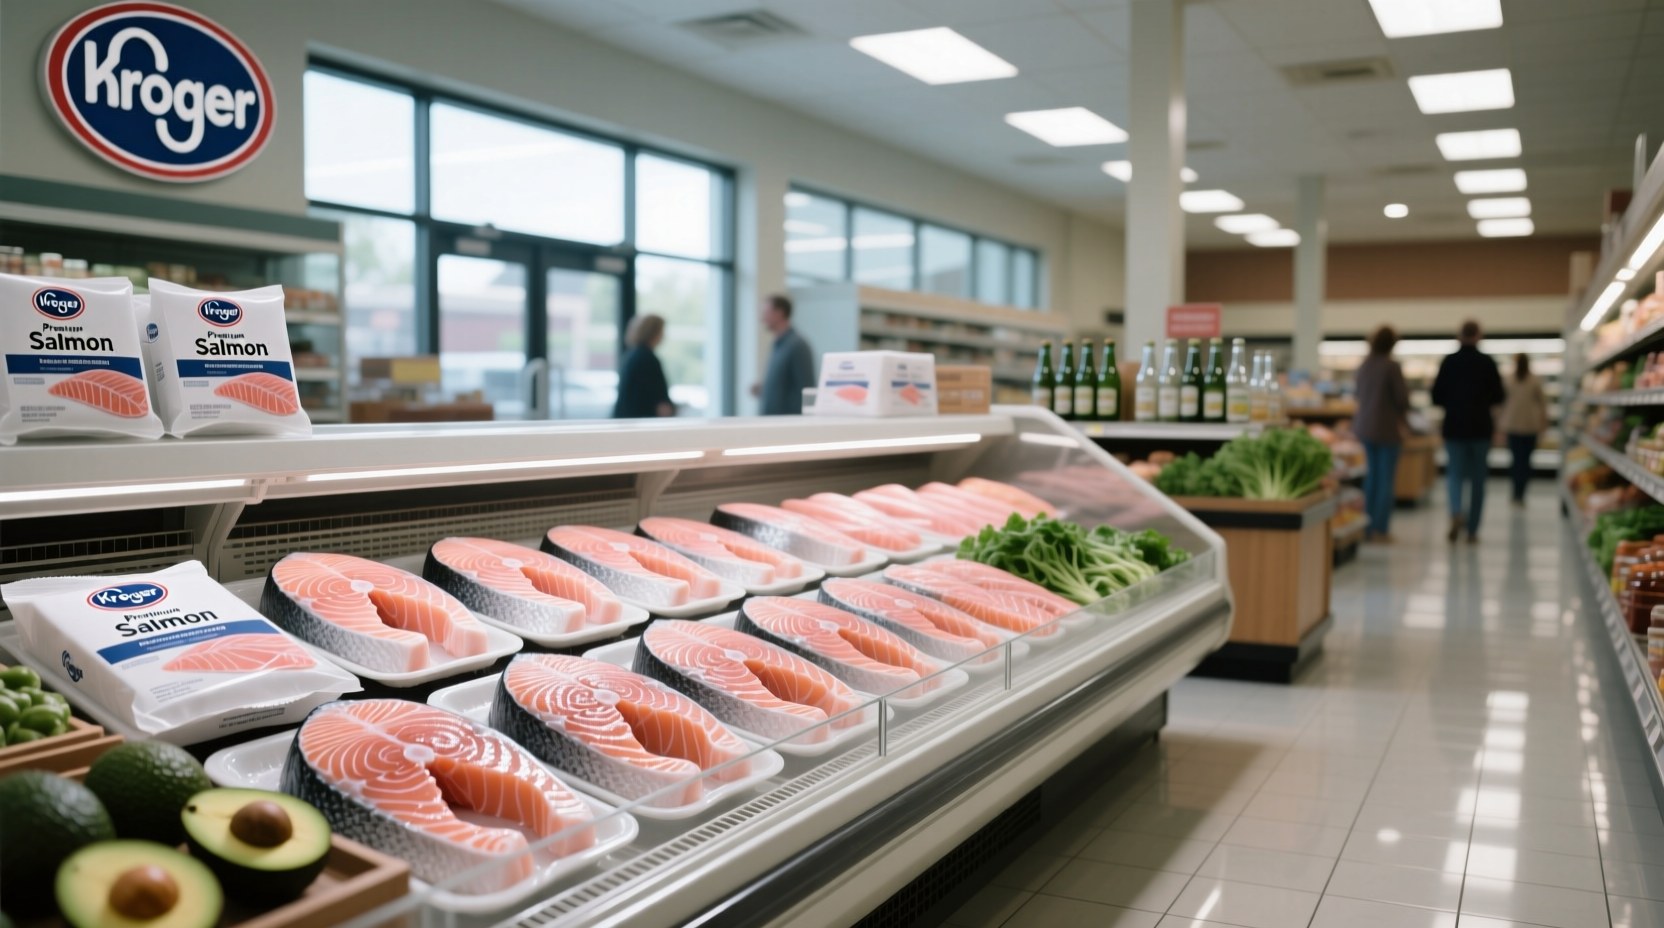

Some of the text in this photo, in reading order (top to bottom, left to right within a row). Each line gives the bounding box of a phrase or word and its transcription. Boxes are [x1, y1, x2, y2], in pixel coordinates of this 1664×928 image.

[84, 26, 256, 154] Kroger
[29, 331, 114, 352] Salmon
[195, 338, 269, 356] Salmon
[115, 610, 218, 637] Salmon
